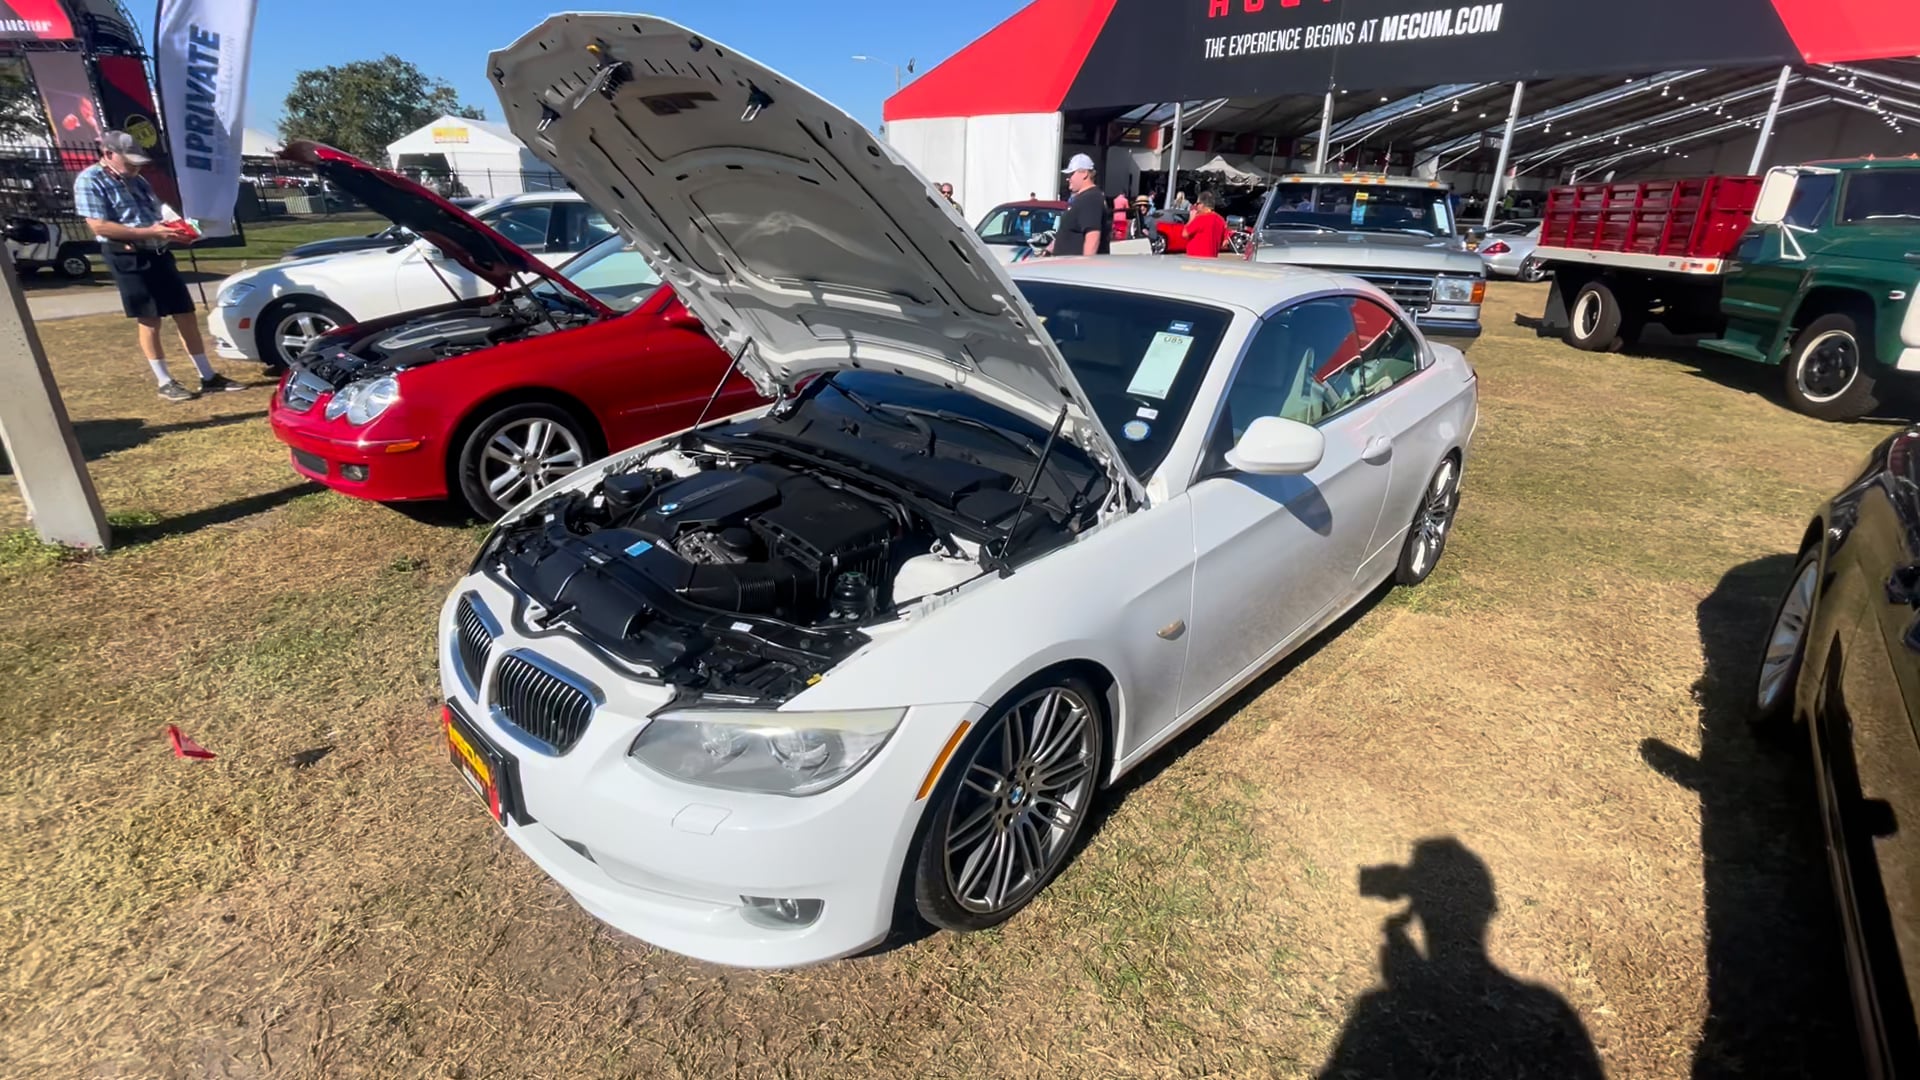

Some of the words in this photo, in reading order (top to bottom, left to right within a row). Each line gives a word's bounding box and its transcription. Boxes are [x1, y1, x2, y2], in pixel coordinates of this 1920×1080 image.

[1205, 36, 1227, 58] THE
[1228, 28, 1302, 56] EXPERIENCE
[1304, 22, 1356, 48] BEGINS
[1358, 19, 1379, 43] AT
[1380, 3, 1503, 42] MECUM.COM
[185, 23, 220, 153] PRIVATE
